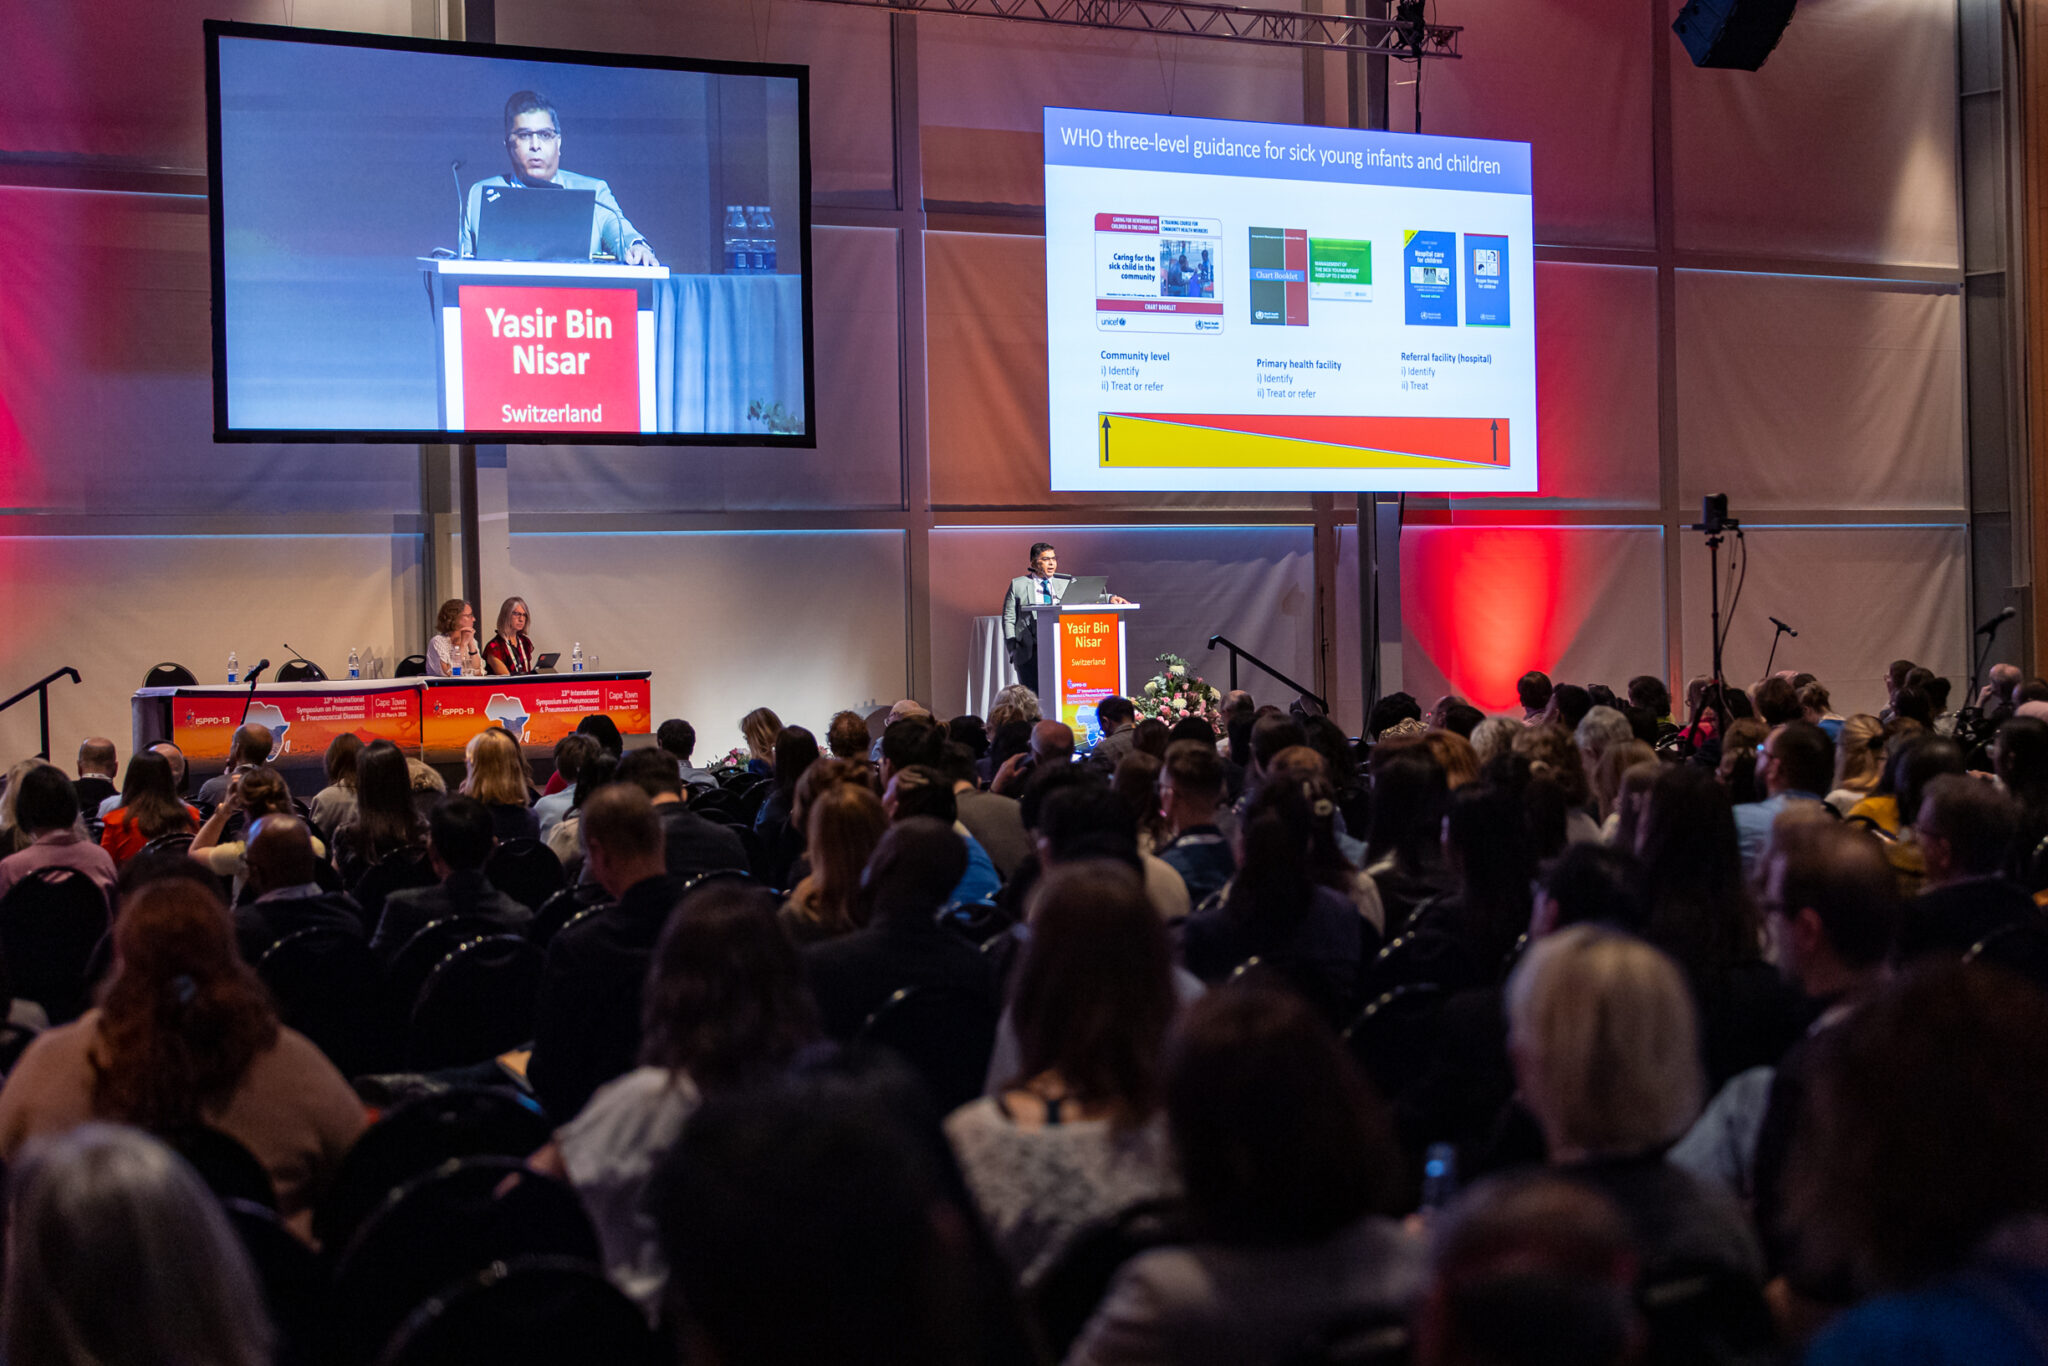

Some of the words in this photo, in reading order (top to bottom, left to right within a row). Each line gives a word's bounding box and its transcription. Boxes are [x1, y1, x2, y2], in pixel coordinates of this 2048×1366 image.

[1060, 127, 1102, 148] WHO
[1107, 130, 1189, 153] three-level
[1194, 138, 1260, 158] guidance
[1264, 141, 1286, 160] for
[1289, 144, 1316, 162] sick
[1319, 149, 1363, 169] young
[1367, 149, 1413, 168] infants
[1417, 153, 1442, 170] and
[1447, 154, 1500, 174] children
[1114, 253, 1133, 262] Caring
[1121, 273, 1156, 282] community
[1256, 271, 1273, 279] Chart
[1275, 272, 1298, 280] Booklet
[485, 307, 557, 338] Yasir
[566, 309, 612, 339] Bin
[513, 344, 590, 375] Nisar
[1100, 350, 1148, 362] Community
[1150, 352, 1170, 361] level
[1401, 352, 1430, 362] Referral
[1432, 353, 1456, 363] facility
[1458, 353, 1492, 364] (hospital)
[1257, 359, 1287, 370] Primary
[1290, 359, 1314, 369] health
[1316, 360, 1341, 371] facility
[1101, 366, 1106, 376] i)
[1108, 366, 1140, 377] Identify
[1401, 367, 1406, 377] i)
[1408, 367, 1436, 377] Identify
[1257, 374, 1262, 384] i)
[1264, 374, 1294, 384] Identify
[1111, 381, 1131, 391] Treat
[1145, 382, 1164, 391] refer
[1410, 381, 1428, 390] Treat
[1267, 389, 1286, 398] Treat
[1298, 390, 1316, 398] refer
[502, 403, 602, 423] Switzerland
[1066, 622, 1091, 634] Yasir
[1093, 622, 1109, 633] Bin
[1075, 636, 1102, 648] Nisar
[1071, 658, 1106, 666] Switzerland
[609, 691, 623, 700] Cape
[375, 698, 390, 708] Cape
[296, 706, 324, 714] Symposium
